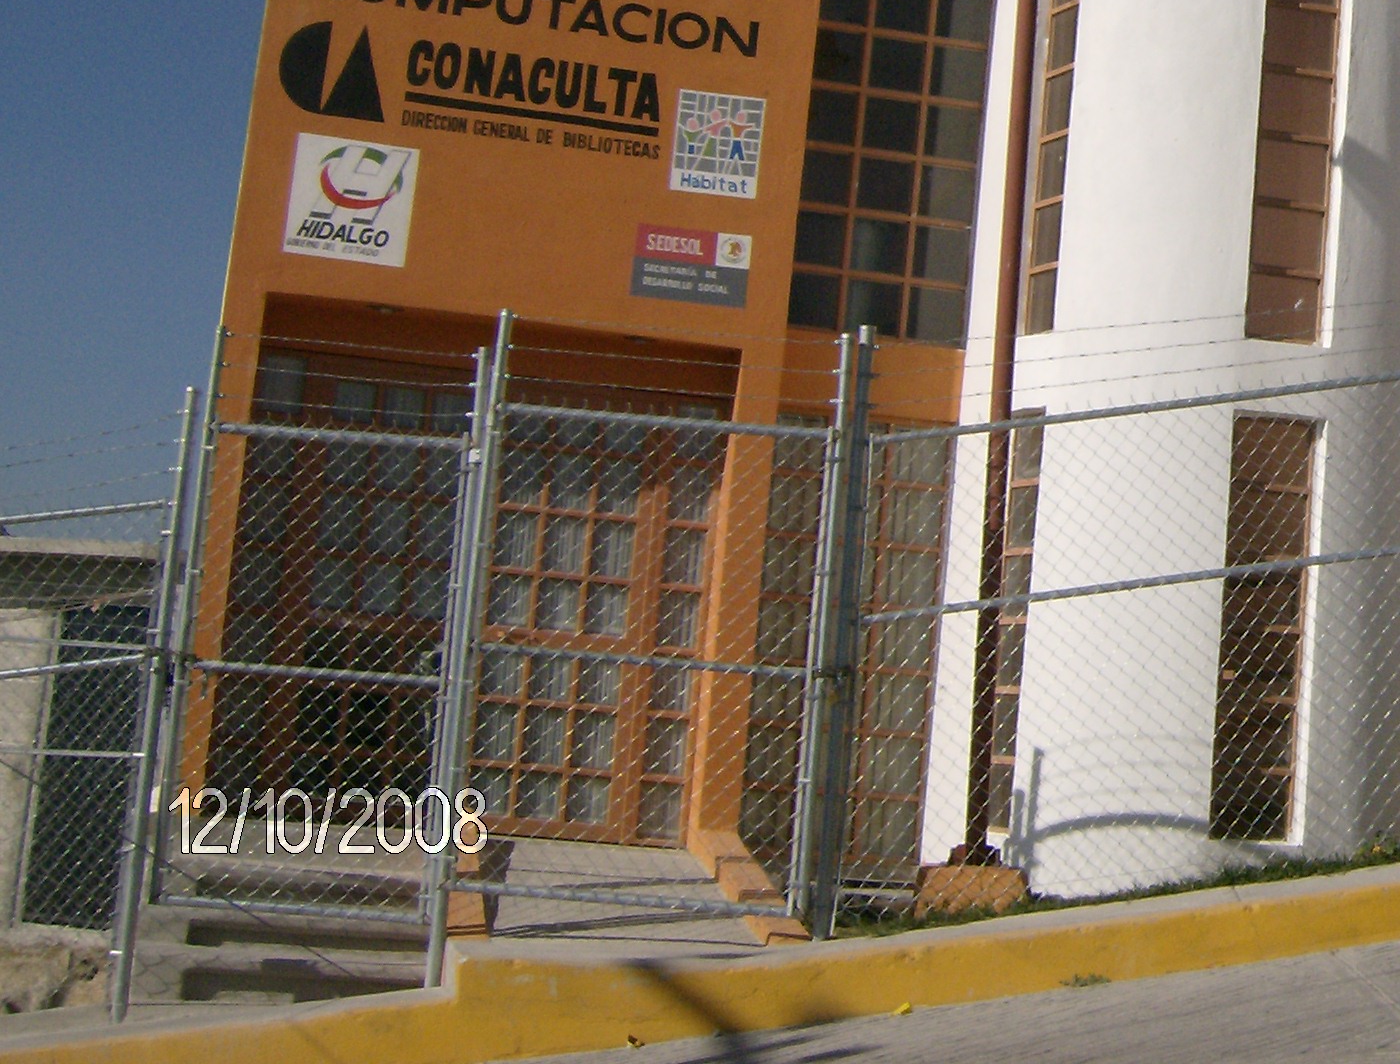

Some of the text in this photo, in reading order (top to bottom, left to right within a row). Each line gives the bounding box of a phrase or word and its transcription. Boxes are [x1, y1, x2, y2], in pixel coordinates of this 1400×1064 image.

[406, 39, 660, 123] CONACULTA
[401, 109, 661, 160] DIRECCION GENERAL DE BIBLIOTECAS
[680, 172, 748, 194] Habitat
[297, 219, 390, 248] HIDALGO
[646, 233, 704, 256] SEDESOL
